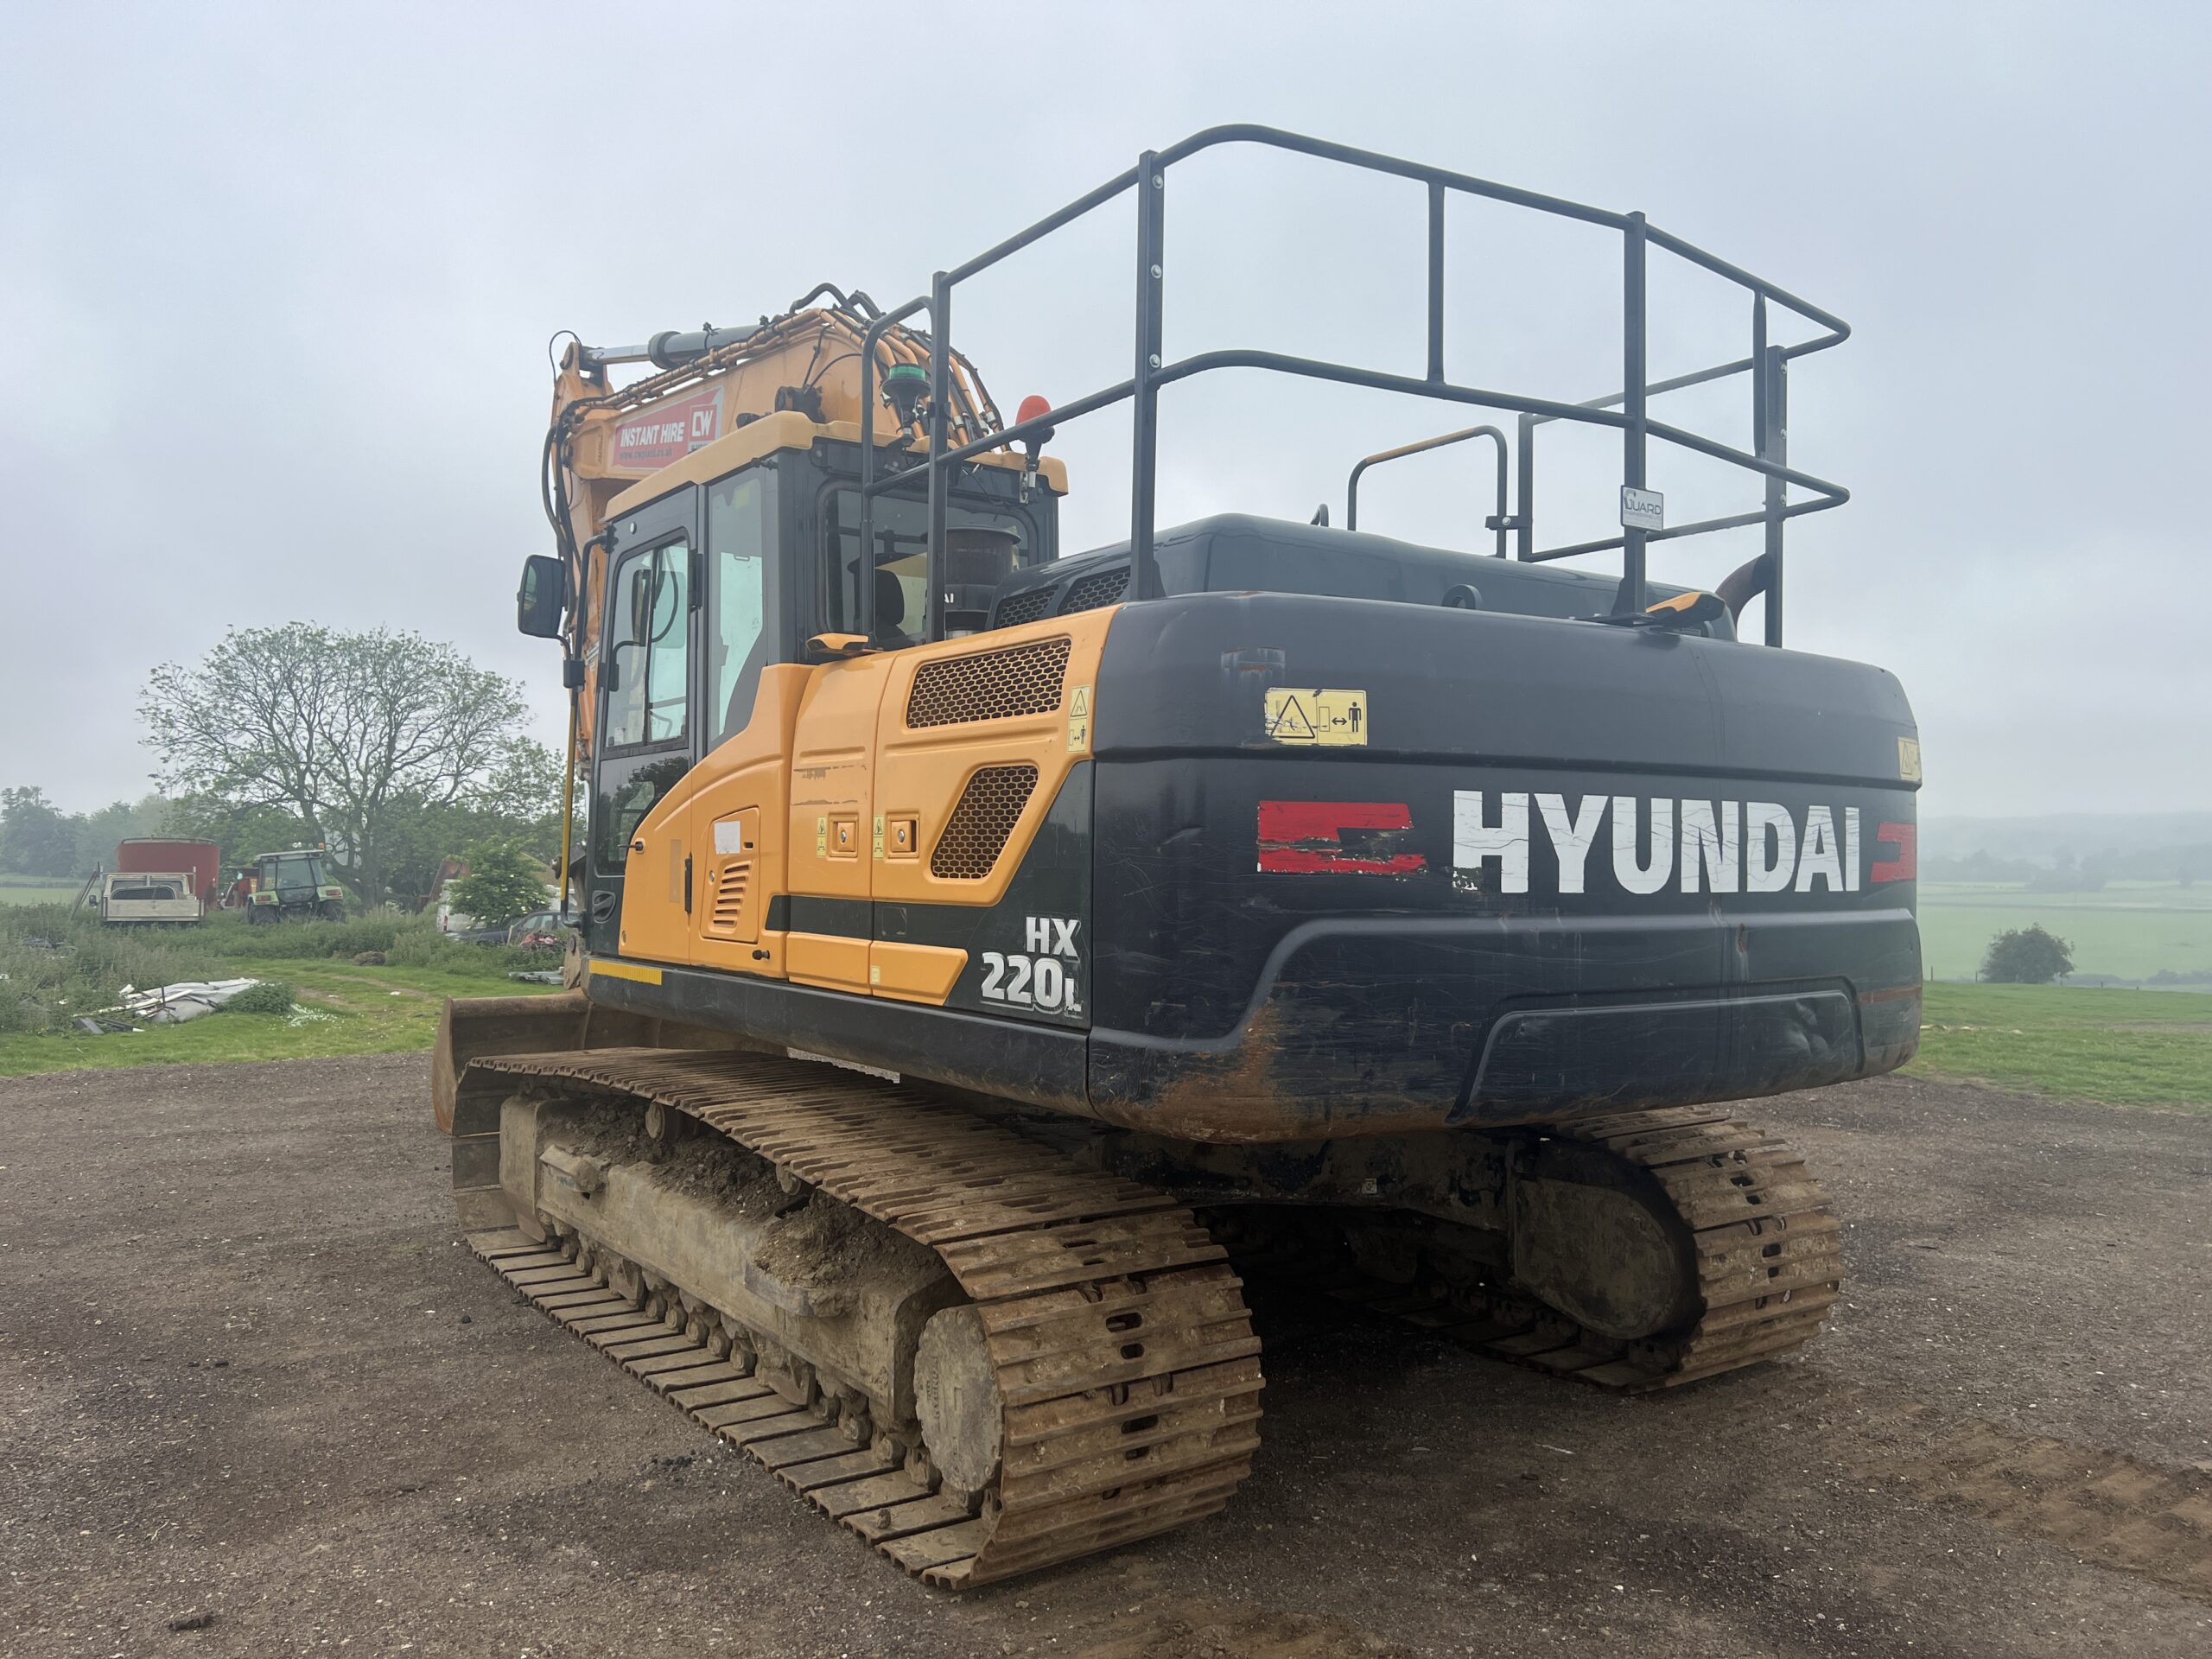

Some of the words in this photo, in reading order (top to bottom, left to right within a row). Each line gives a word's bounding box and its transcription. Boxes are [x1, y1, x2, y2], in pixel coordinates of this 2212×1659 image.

[620, 425, 659, 447] INSTANT
[660, 422, 685, 443] HIRE
[692, 410, 713, 437] CW
[1624, 489, 1662, 515] GUARD
[1452, 790, 1859, 894] HYUNDAI
[1026, 917, 1080, 957] HX
[981, 951, 1082, 1013] 220L
